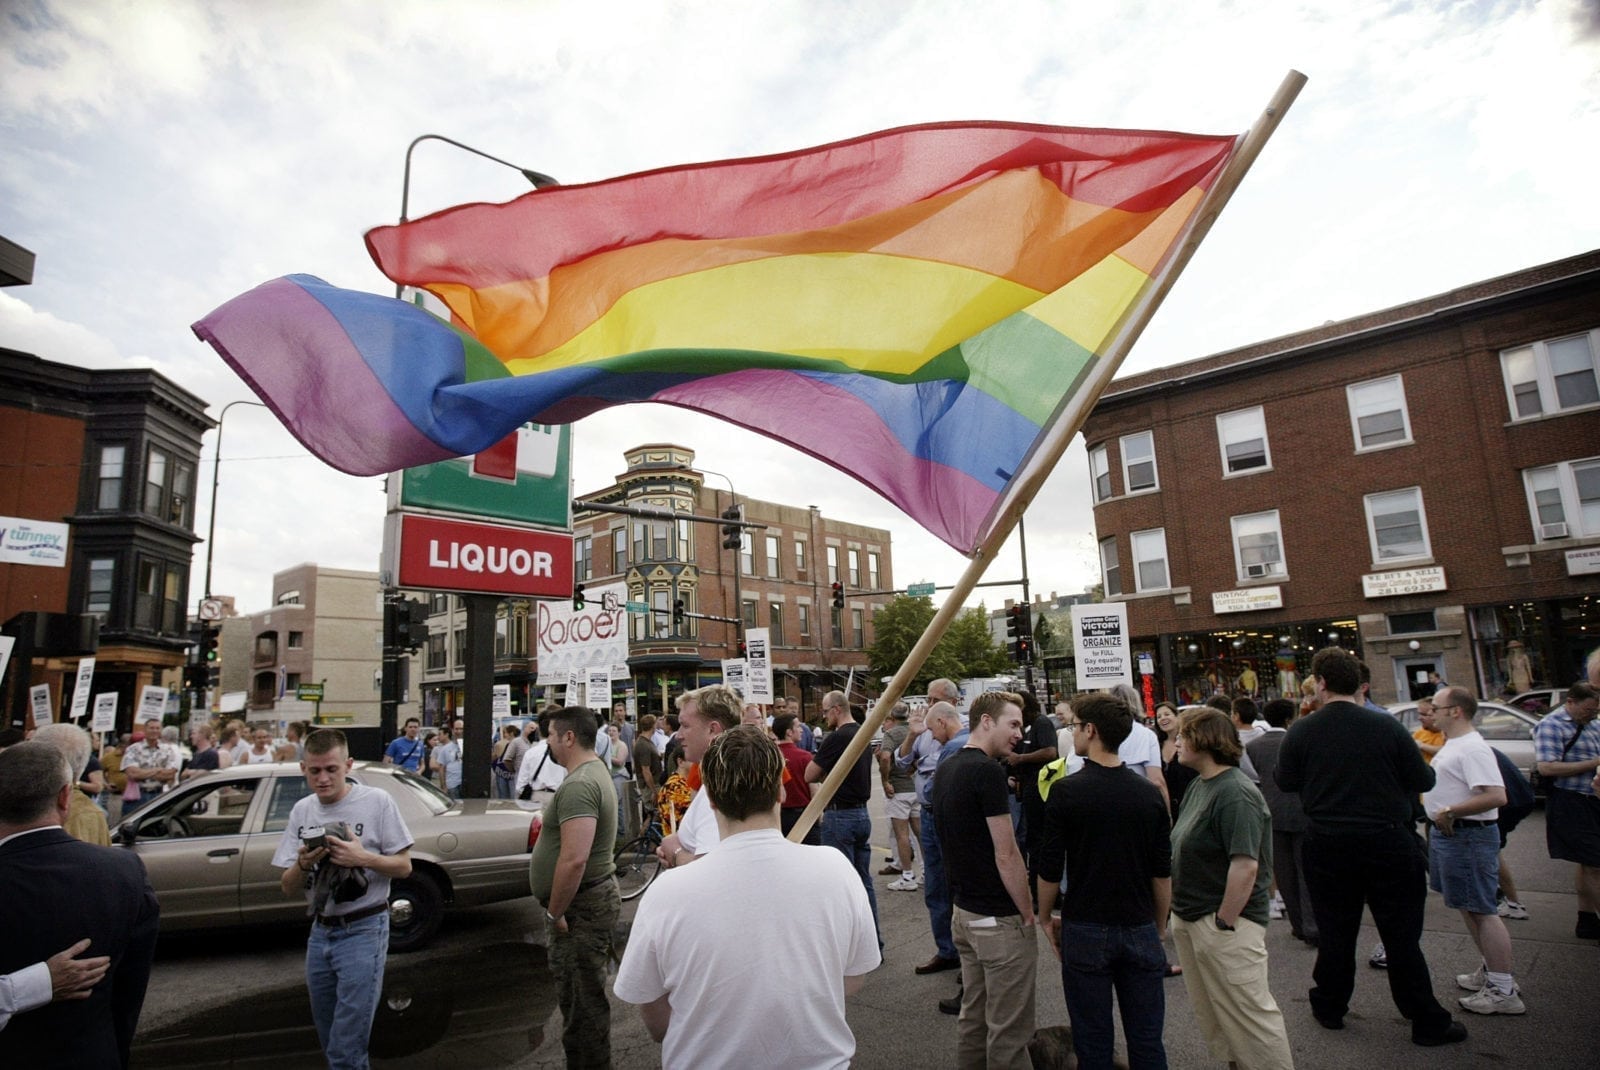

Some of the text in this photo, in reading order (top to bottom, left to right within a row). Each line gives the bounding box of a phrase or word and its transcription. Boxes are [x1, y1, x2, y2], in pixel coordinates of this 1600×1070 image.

[10, 528, 61, 546] tunney
[429, 540, 552, 578] LIQUOR
[1214, 590, 1249, 599] VINTAGE
[1378, 584, 1434, 595] 281-6933
[1083, 636, 1122, 647] ORGANIZE
[1098, 656, 1123, 664] equality
[1087, 664, 1122, 673] tomorrow!
